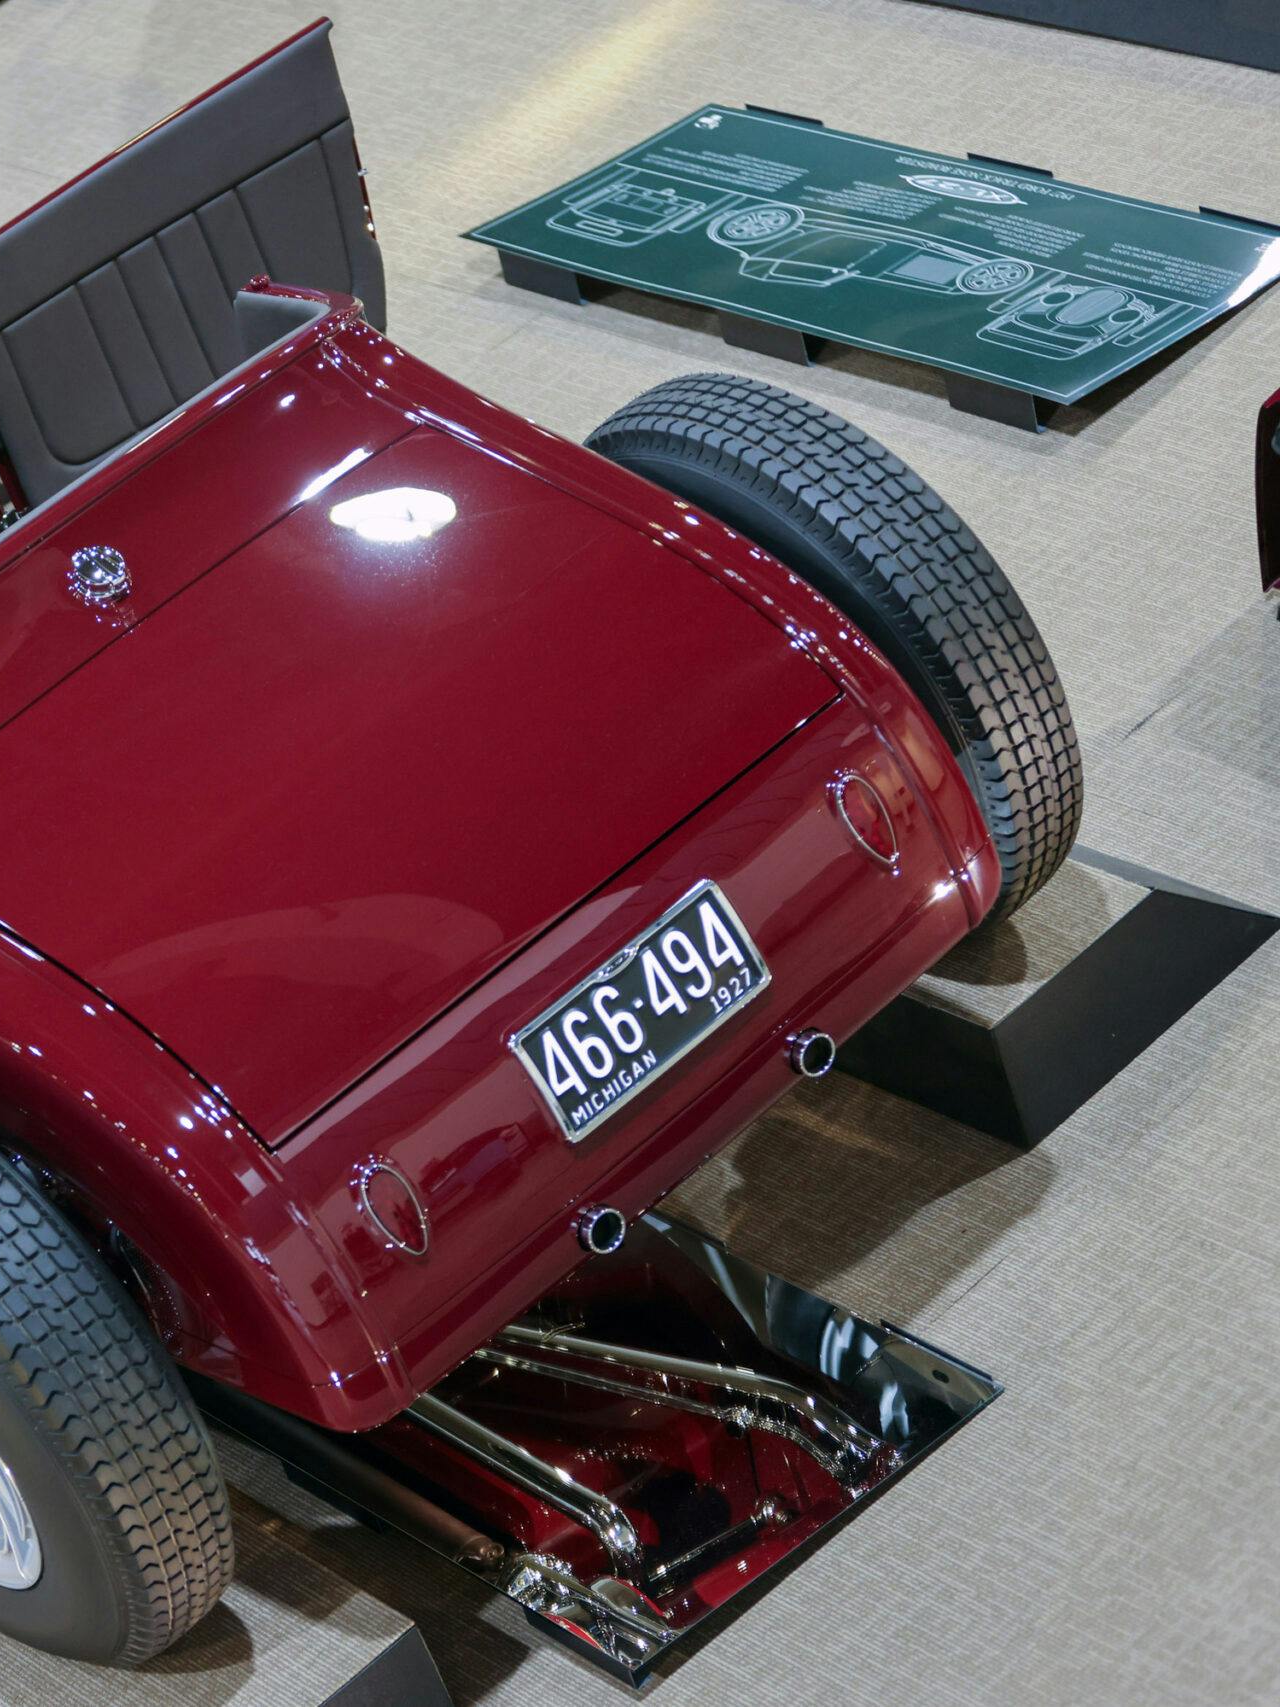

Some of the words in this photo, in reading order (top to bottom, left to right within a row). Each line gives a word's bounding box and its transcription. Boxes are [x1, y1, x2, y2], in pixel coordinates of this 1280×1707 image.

[1018, 182, 1051, 195] FORD
[709, 967, 751, 1014] 1927
[571, 1049, 657, 1126] MICHIGAN
